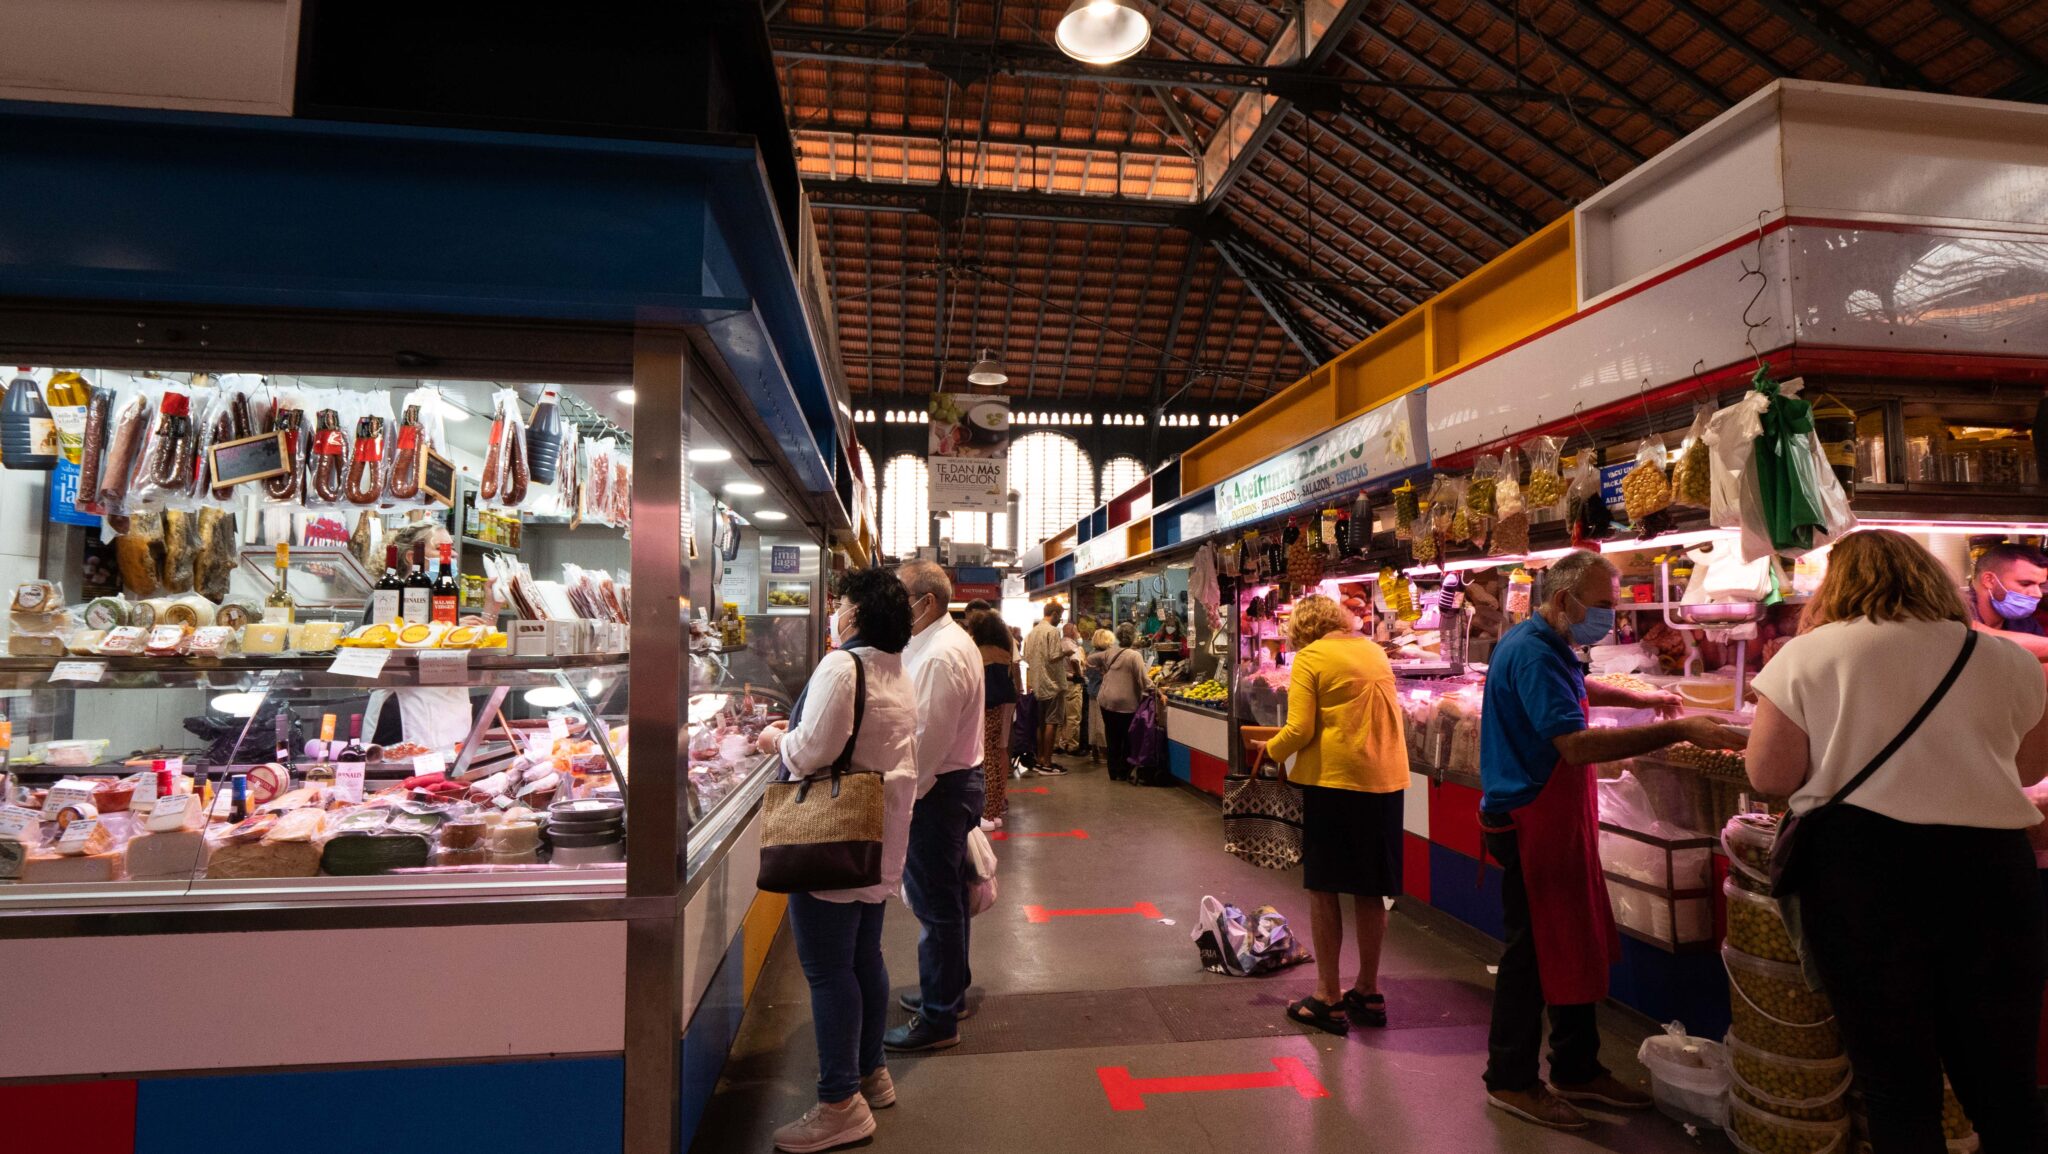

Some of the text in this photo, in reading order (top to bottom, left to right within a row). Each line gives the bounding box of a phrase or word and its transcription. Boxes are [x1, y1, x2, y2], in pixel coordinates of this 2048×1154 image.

[936, 463, 1000, 475] TE DAN MÁS
[1281, 489, 1297, 504] SECOS
[1335, 463, 1368, 485] ESPECIAS
